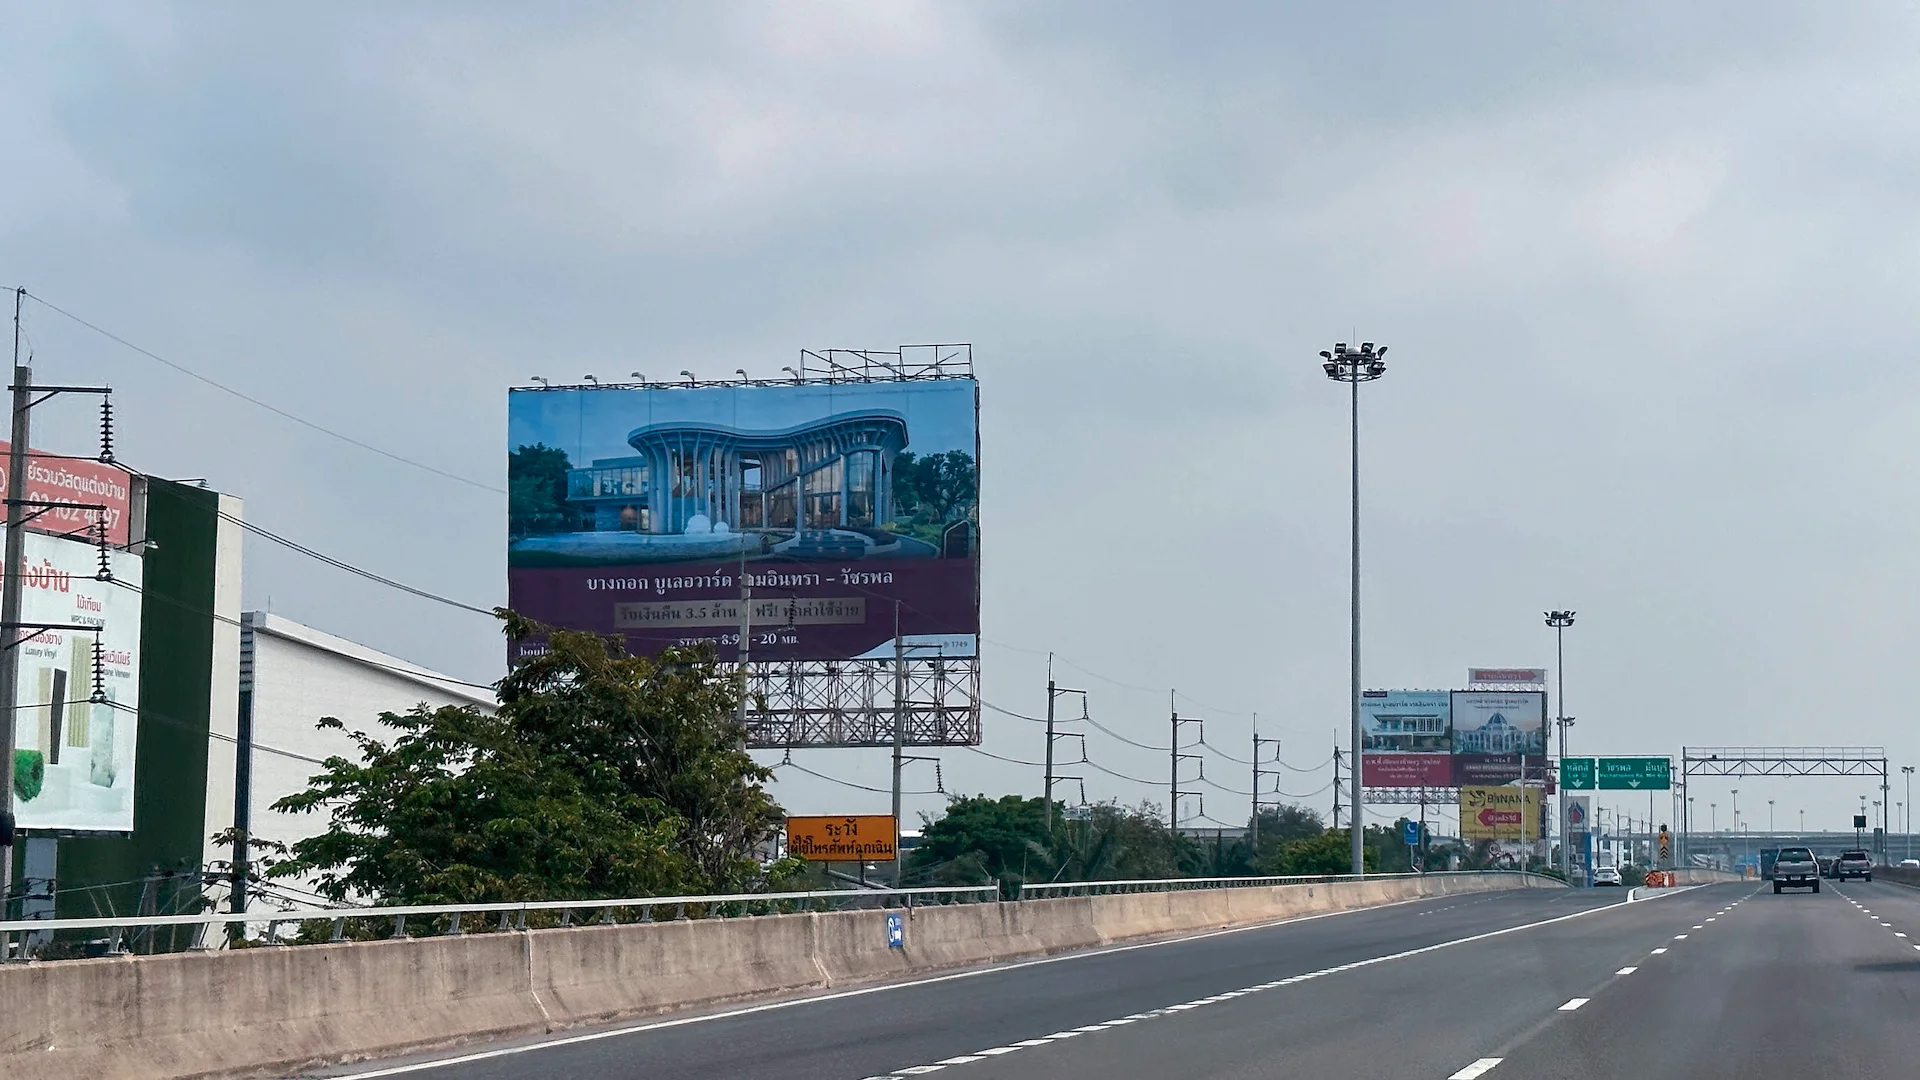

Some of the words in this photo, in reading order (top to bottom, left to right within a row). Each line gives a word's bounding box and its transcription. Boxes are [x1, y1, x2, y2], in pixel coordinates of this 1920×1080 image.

[586, 577, 648, 591] บางกอก
[654, 567, 732, 595] บูเลอวาร์ด
[840, 567, 893, 586] วัชรพล
[685, 607, 706, 620] 3.5
[760, 633, 777, 645] 20
[825, 818, 858, 837] ระวัง
